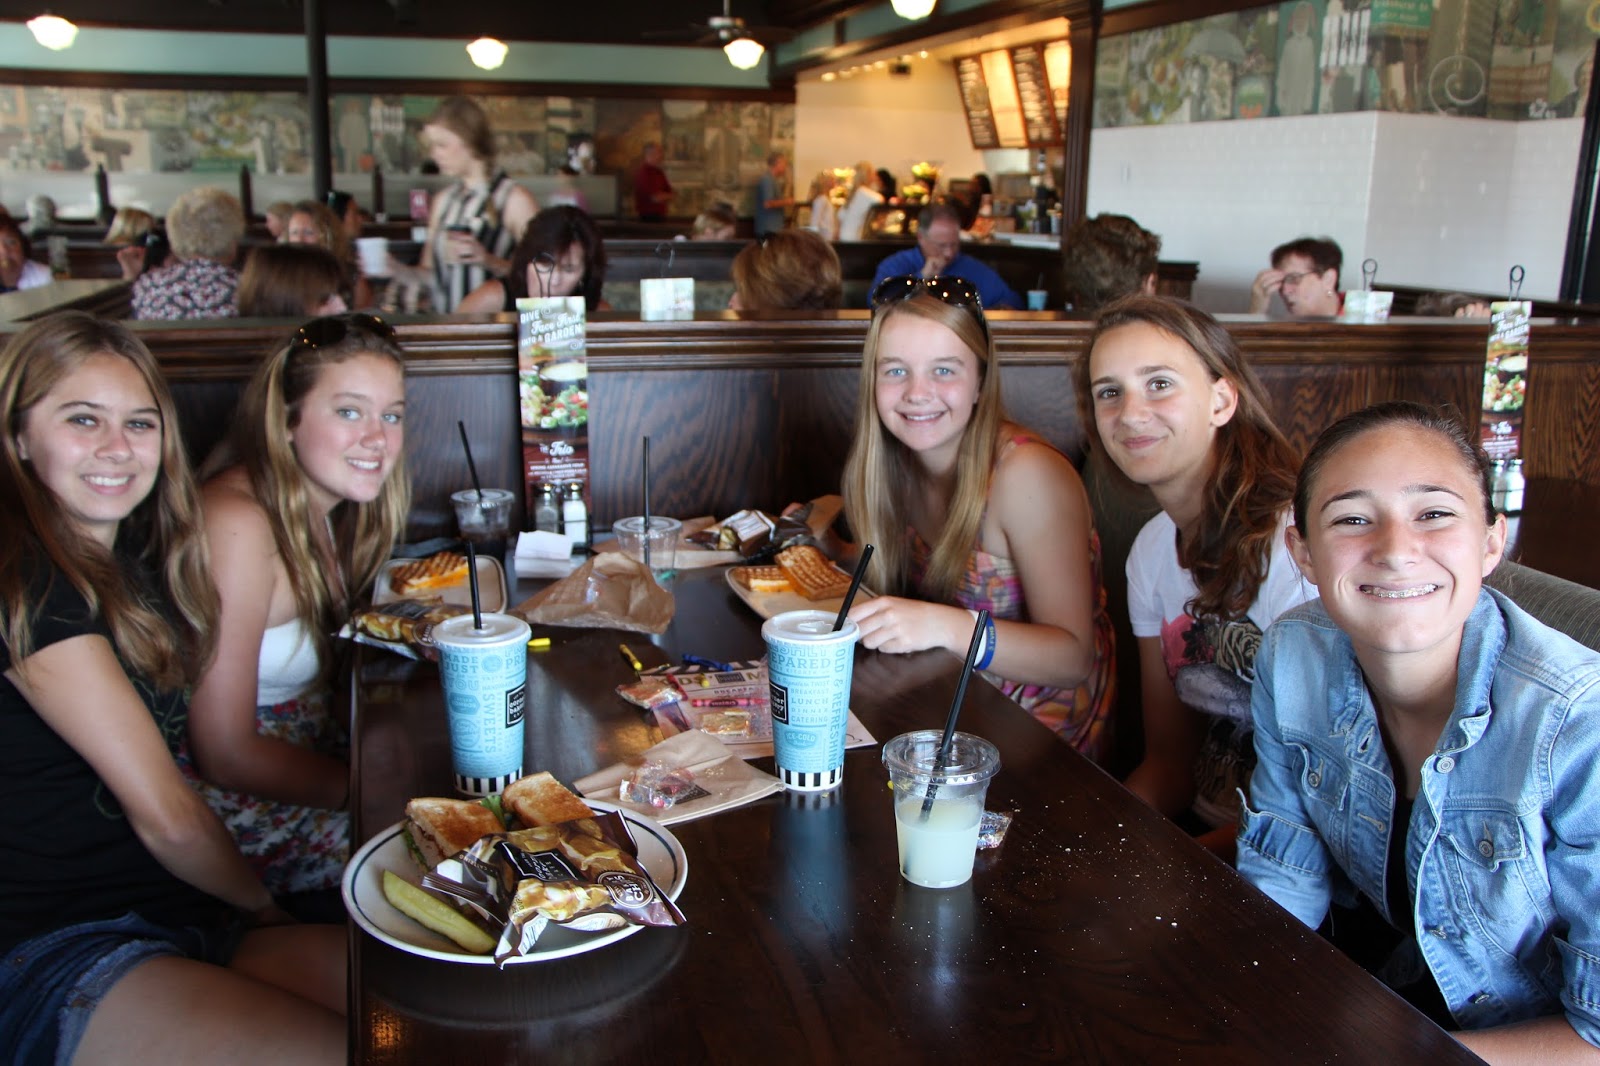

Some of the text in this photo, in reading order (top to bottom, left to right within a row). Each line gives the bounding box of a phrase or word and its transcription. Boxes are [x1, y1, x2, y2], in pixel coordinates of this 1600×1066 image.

[520, 309, 540, 324] DIVE
[531, 312, 581, 334] Face First
[544, 323, 582, 343] GARDEN
[550, 440, 573, 456] Trio
[444, 652, 479, 664] MADE
[444, 662, 479, 673] JUST
[446, 677, 479, 691] YOU
[482, 693, 497, 754] SWEETS
[791, 715, 828, 724] CATERING
[786, 732, 816, 742] ICE-COLD
[827, 692, 843, 770] REFRESHING
